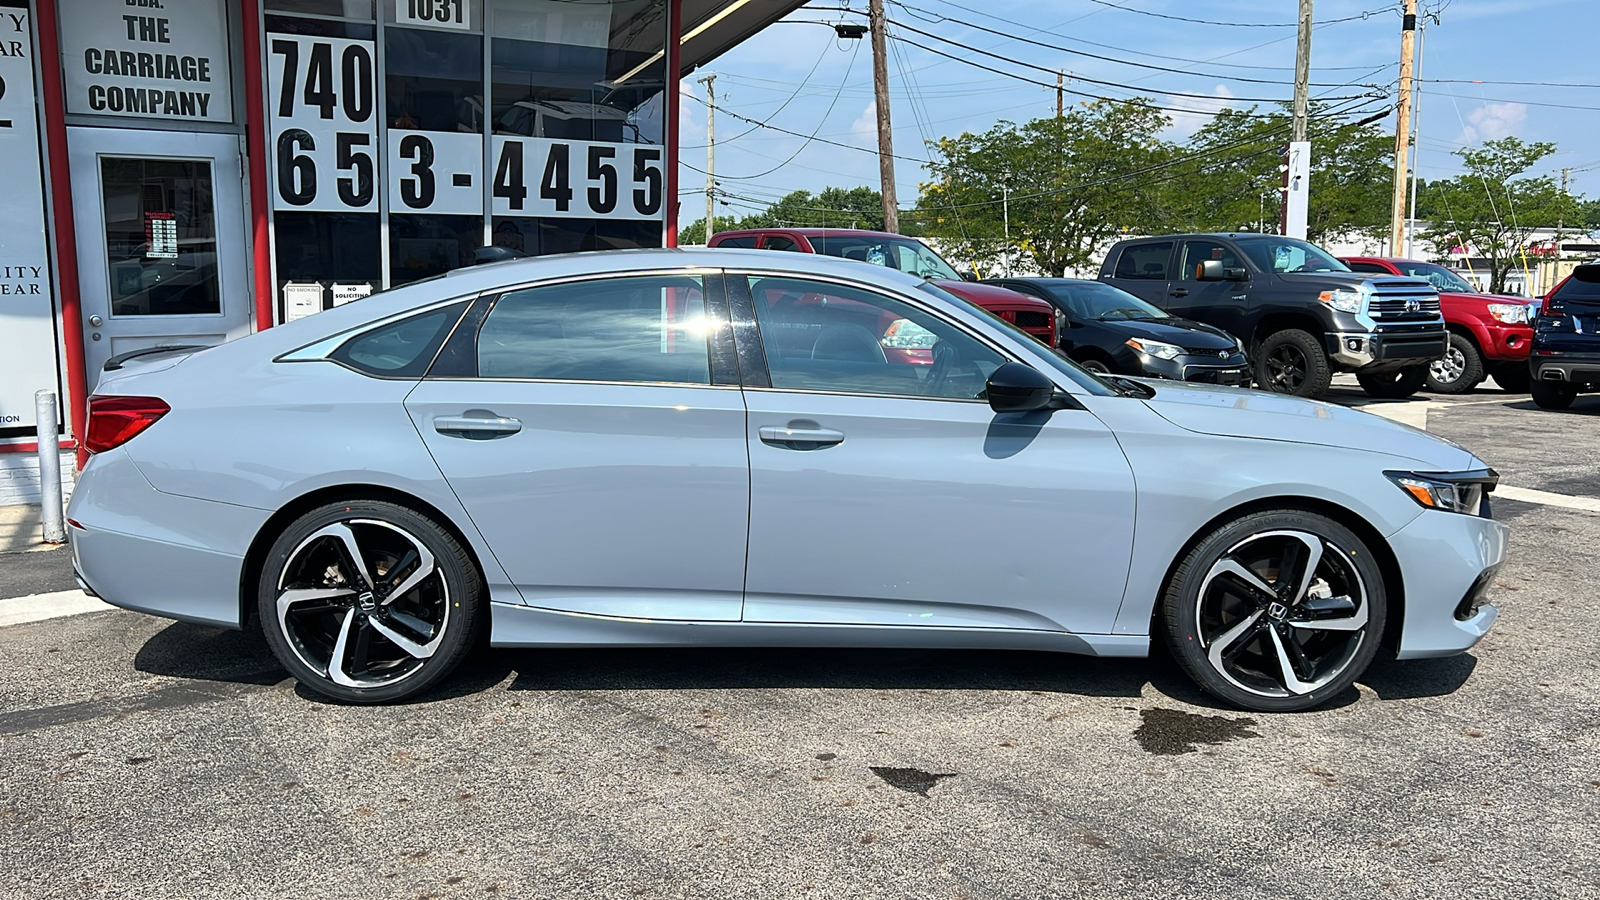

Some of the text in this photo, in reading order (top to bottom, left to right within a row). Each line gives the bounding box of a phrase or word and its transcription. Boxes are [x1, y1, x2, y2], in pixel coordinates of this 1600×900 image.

[408, 0, 463, 24] 1031
[122, 14, 171, 44] THE
[84, 47, 211, 83] CARRIAGE
[272, 39, 374, 123] 740
[88, 85, 211, 118] COMPANY
